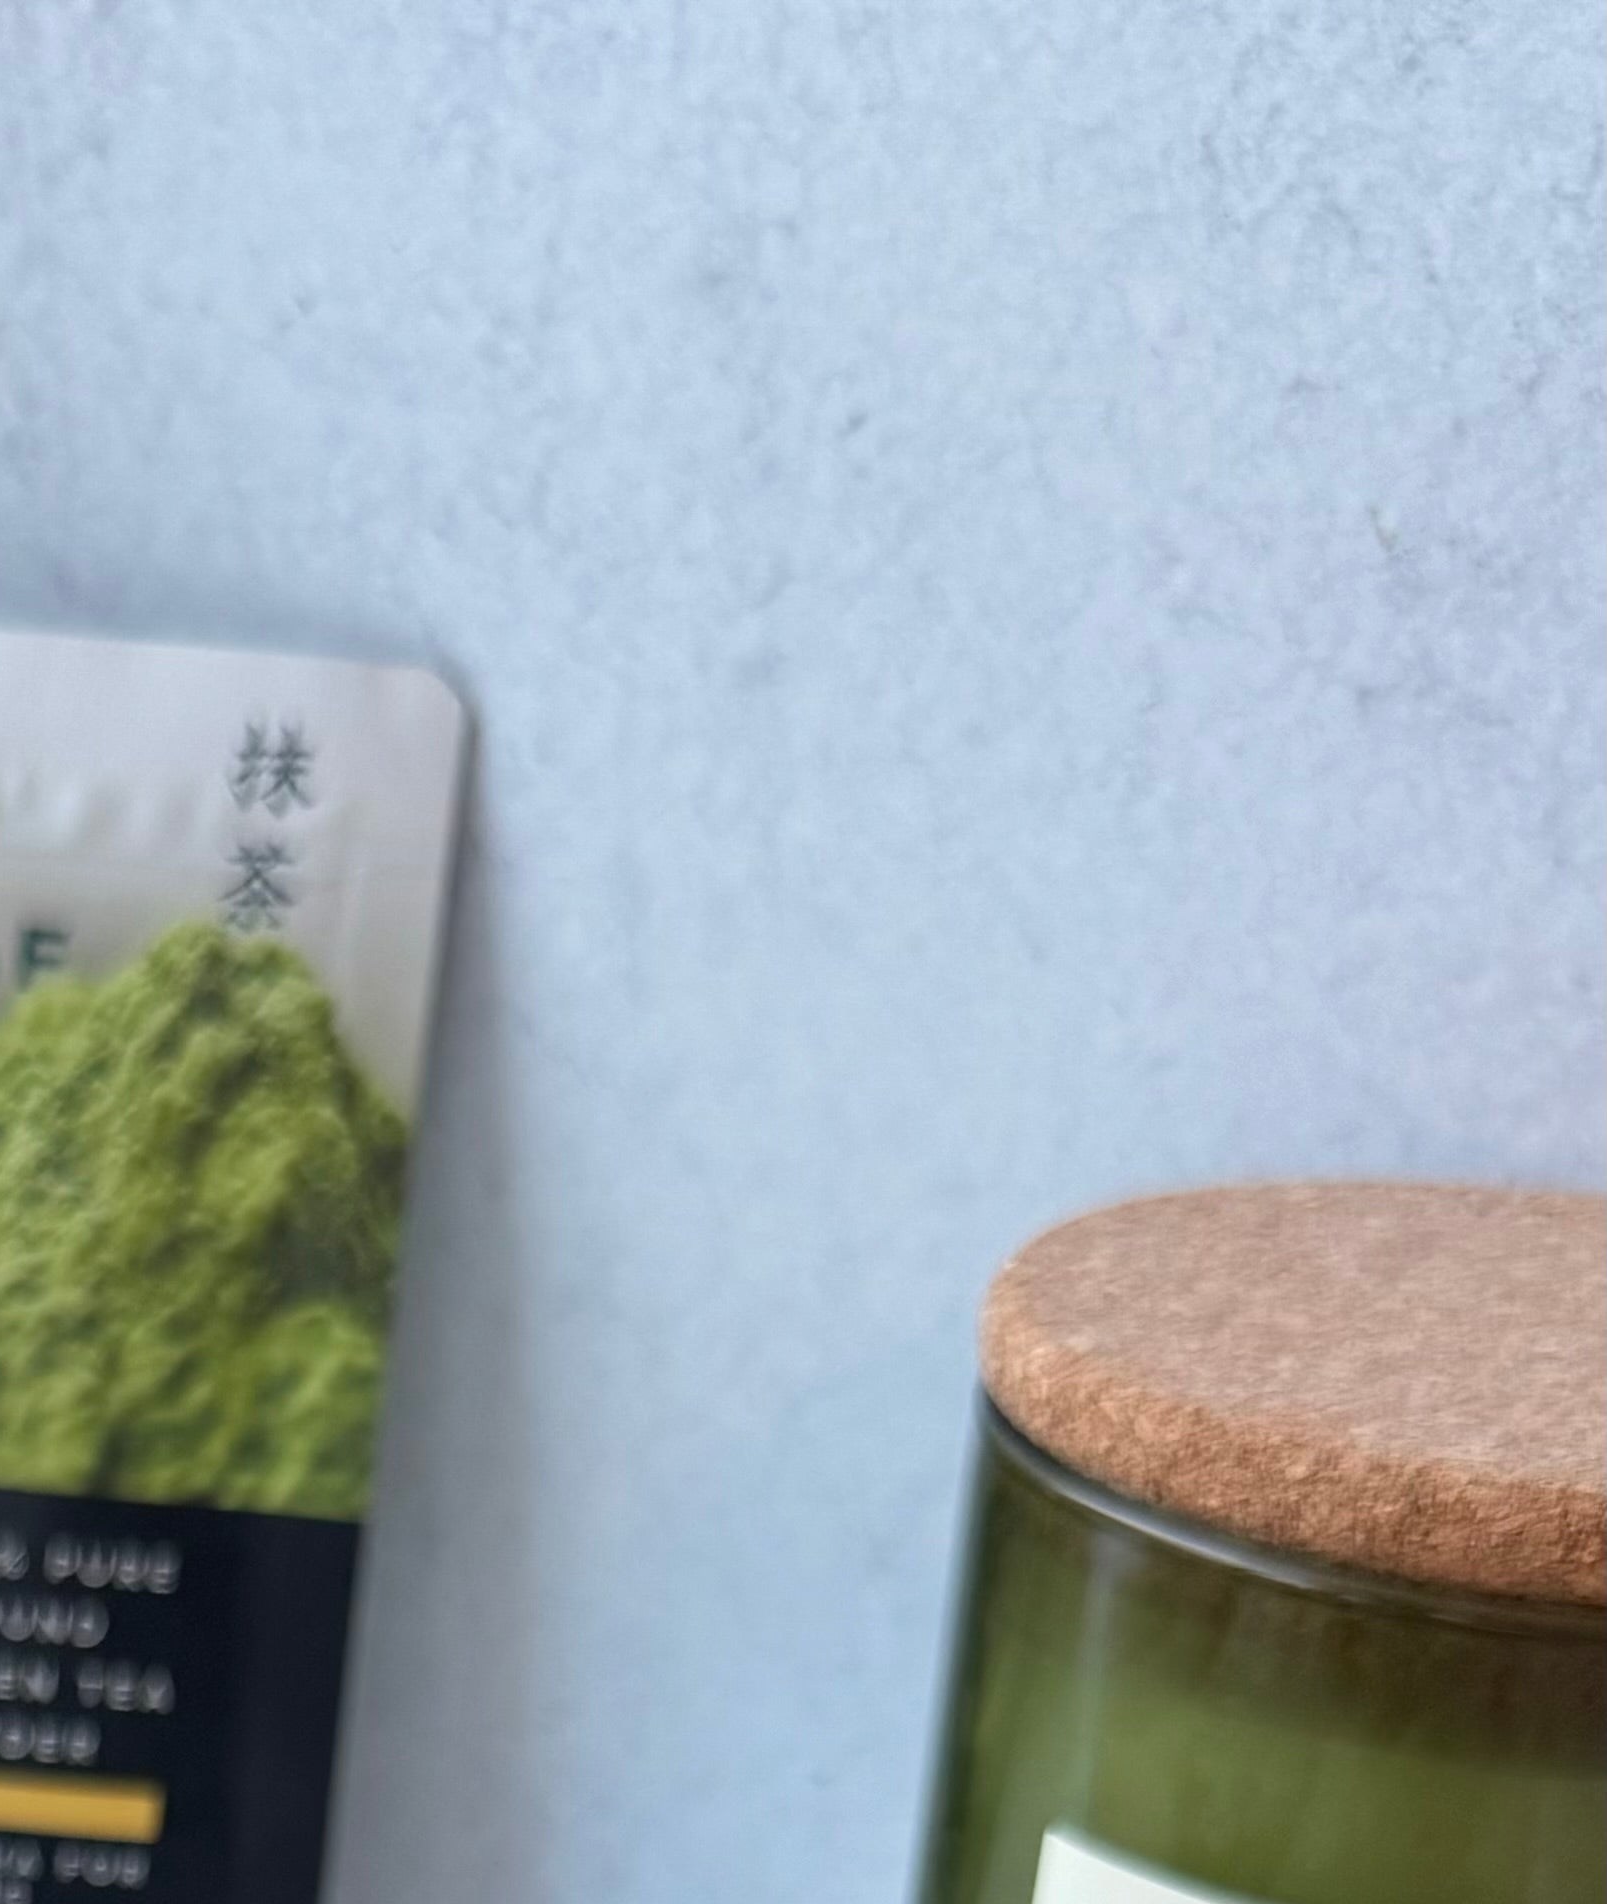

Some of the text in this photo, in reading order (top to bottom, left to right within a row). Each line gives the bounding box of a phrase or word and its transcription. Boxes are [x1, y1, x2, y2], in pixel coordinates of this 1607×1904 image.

[220, 718, 316, 932] 抹茶
[43, 1531, 183, 1595] PURE
[76, 1656, 176, 1716] TEA
[54, 1837, 151, 1891] FOR
